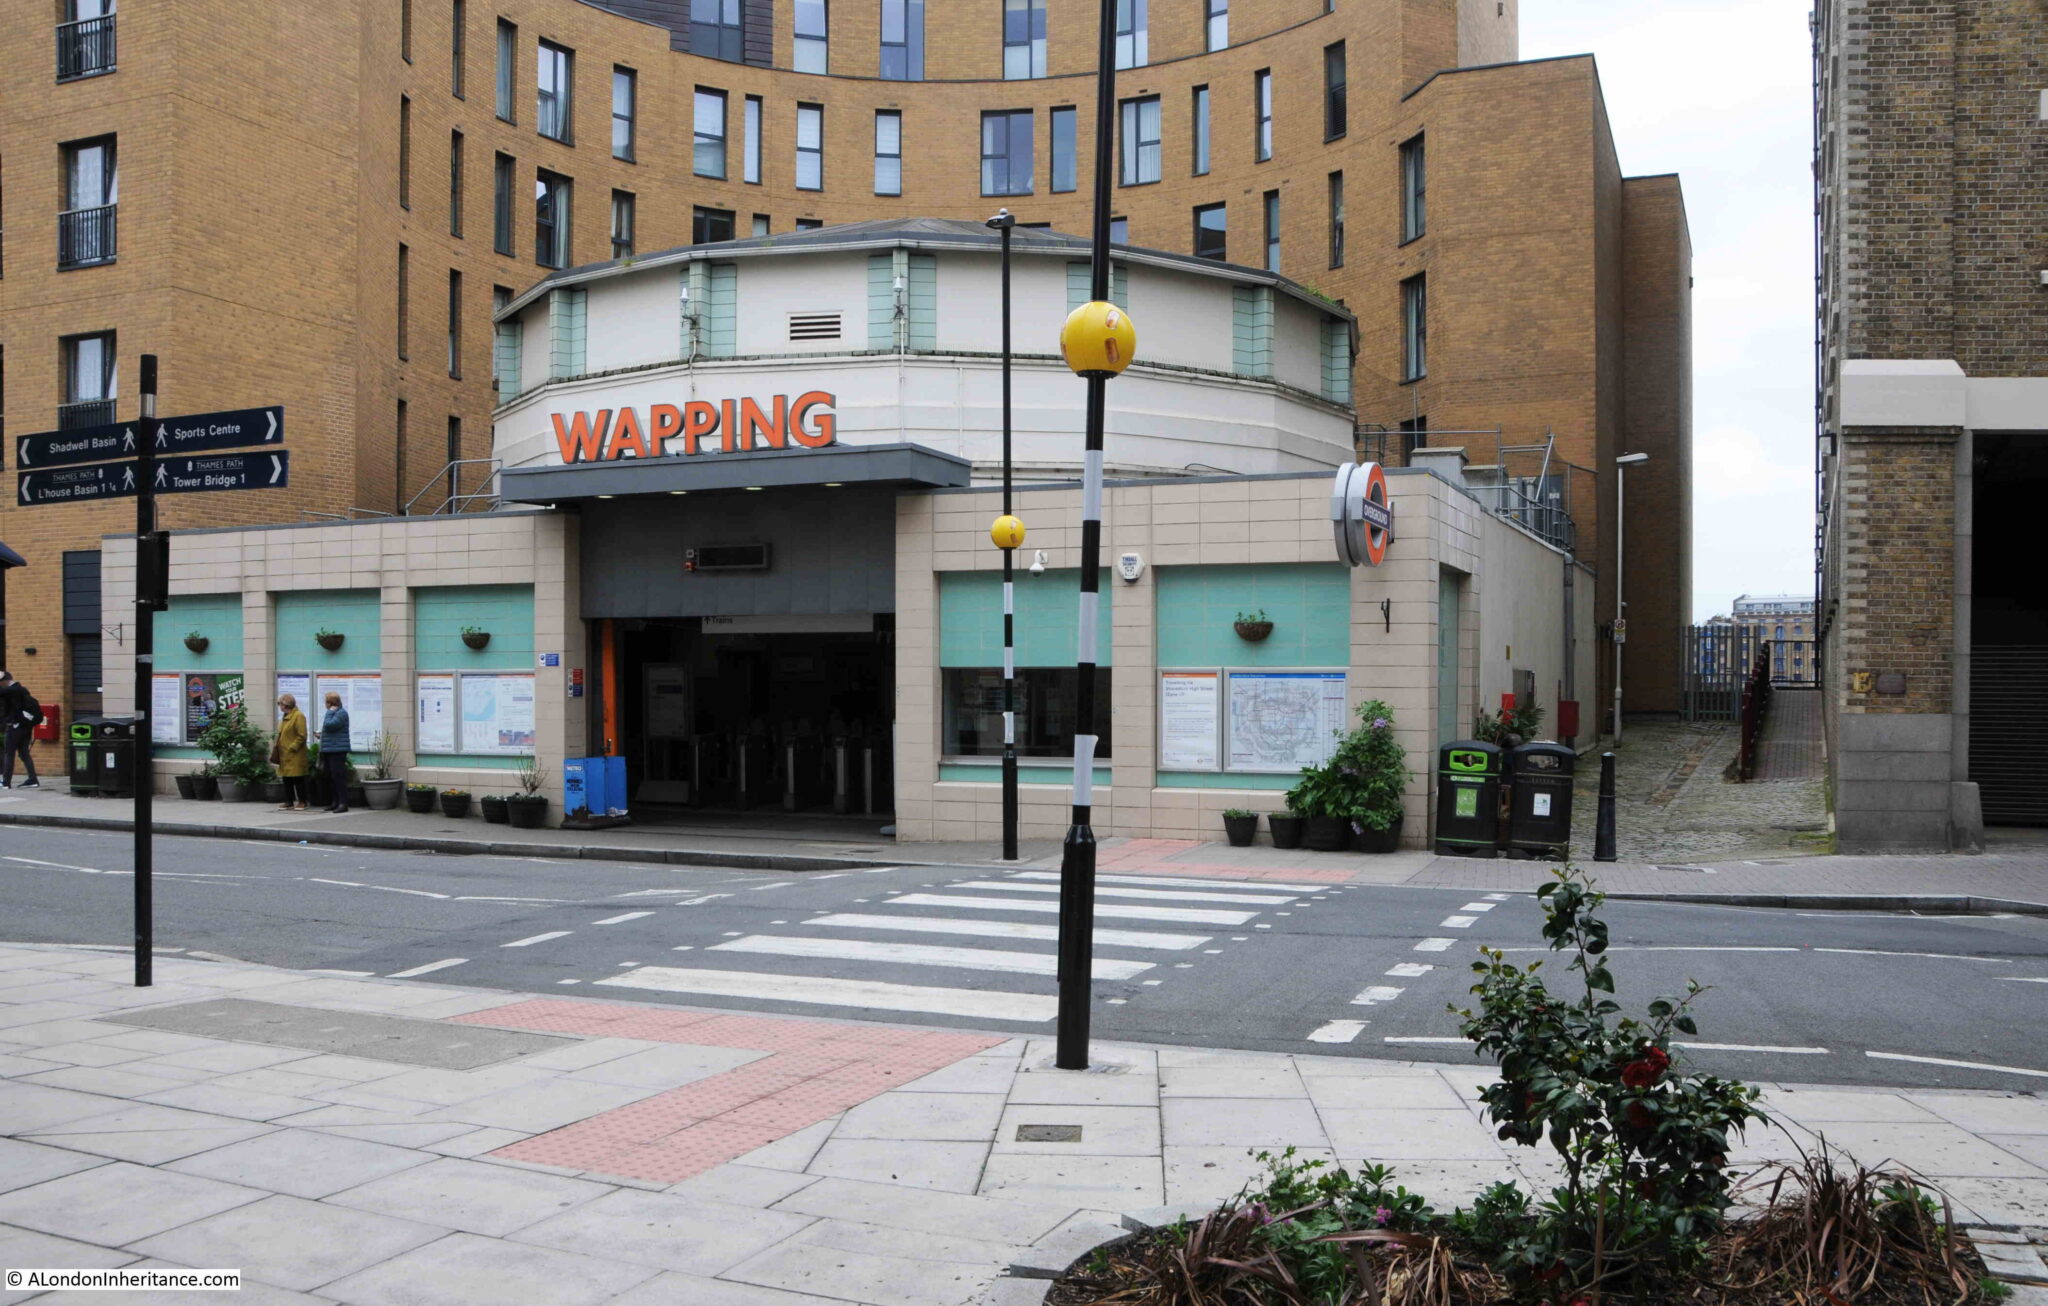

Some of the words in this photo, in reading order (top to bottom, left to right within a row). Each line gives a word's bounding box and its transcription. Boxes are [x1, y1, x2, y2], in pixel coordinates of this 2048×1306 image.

[174, 427, 206, 441] Sports
[209, 423, 241, 436] Centre
[550, 390, 838, 464] WAPPING
[49, 439, 89, 454] Shadwell
[91, 436, 117, 449] Basin
[195, 460, 224, 470] THAMES
[226, 459, 244, 469] PATH
[173, 476, 201, 488] Tower
[204, 474, 237, 487] Bridge
[240, 472, 246, 484] 1
[38, 487, 72, 499] L'house
[74, 483, 99, 496] Basin
[1363, 503, 1388, 526] OVERGROUND
[218, 677, 242, 690] WATCH
[218, 688, 245, 710] STEP
